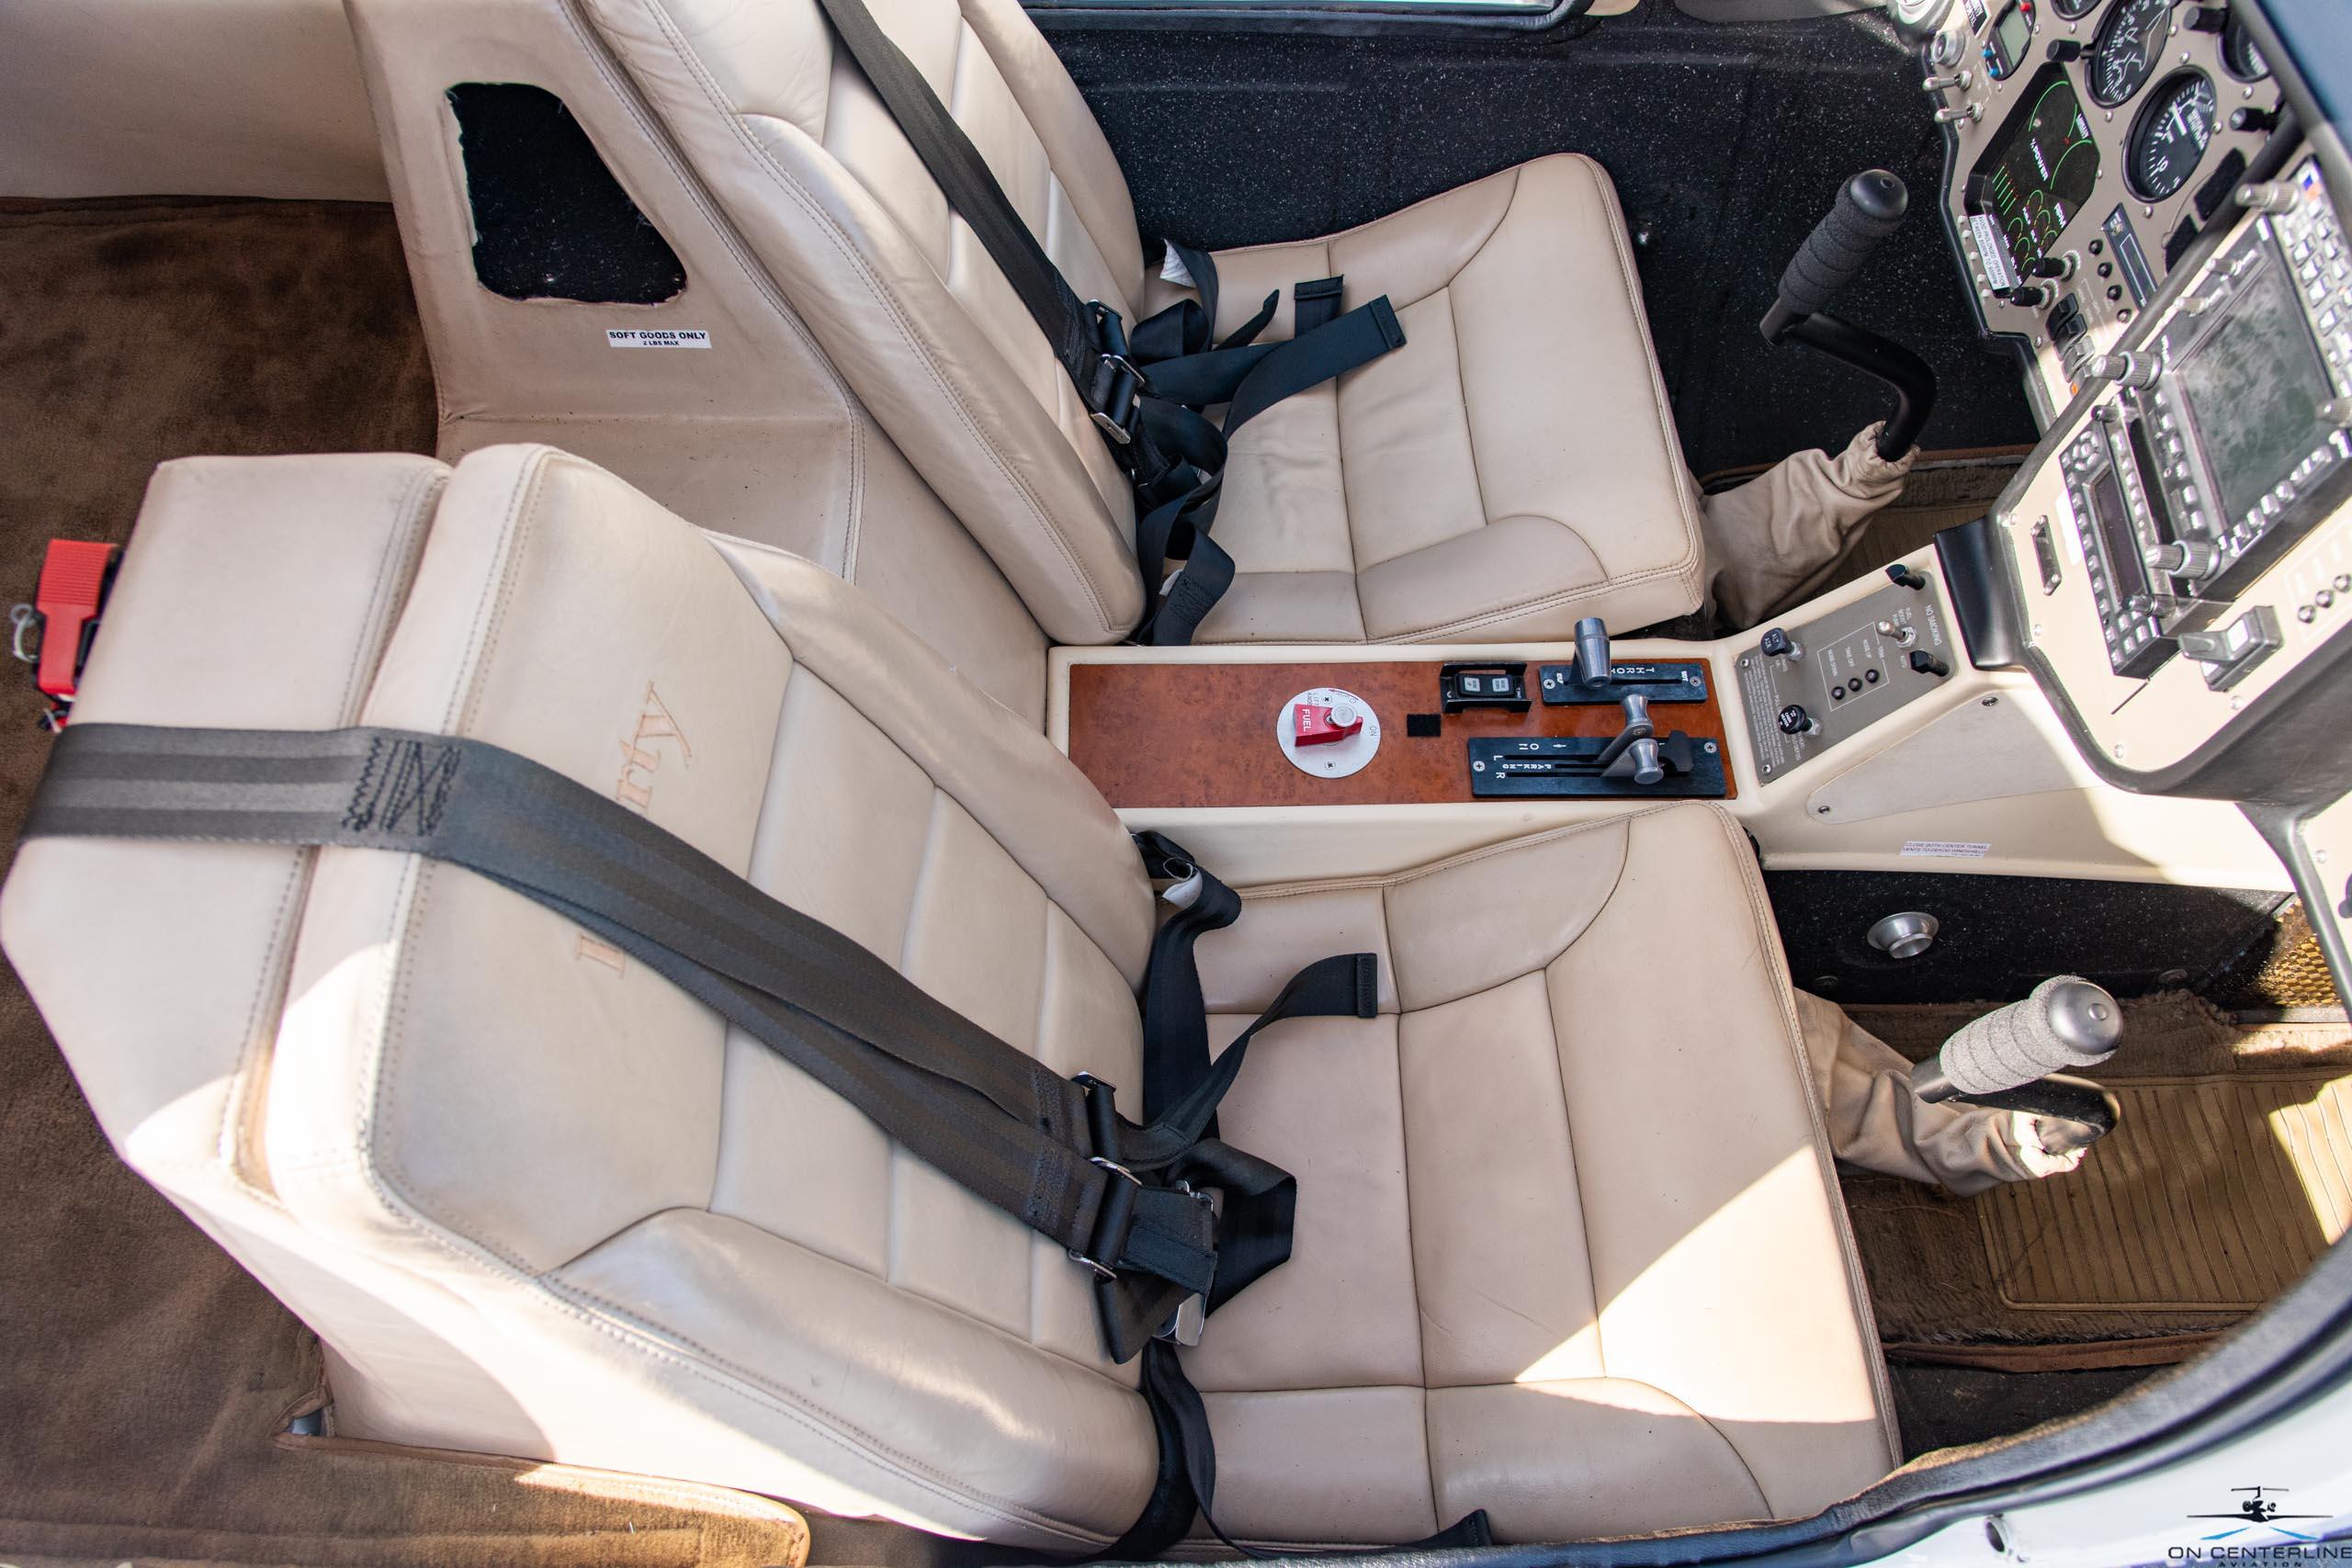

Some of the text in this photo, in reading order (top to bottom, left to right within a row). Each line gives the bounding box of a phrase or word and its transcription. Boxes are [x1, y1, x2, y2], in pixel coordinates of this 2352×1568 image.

[2052, 202, 2067, 227] RPM
[1924, 604, 1942, 645] NO SMOKING
[1302, 709, 1312, 731] FUEL
[1370, 726, 1377, 736] ON
